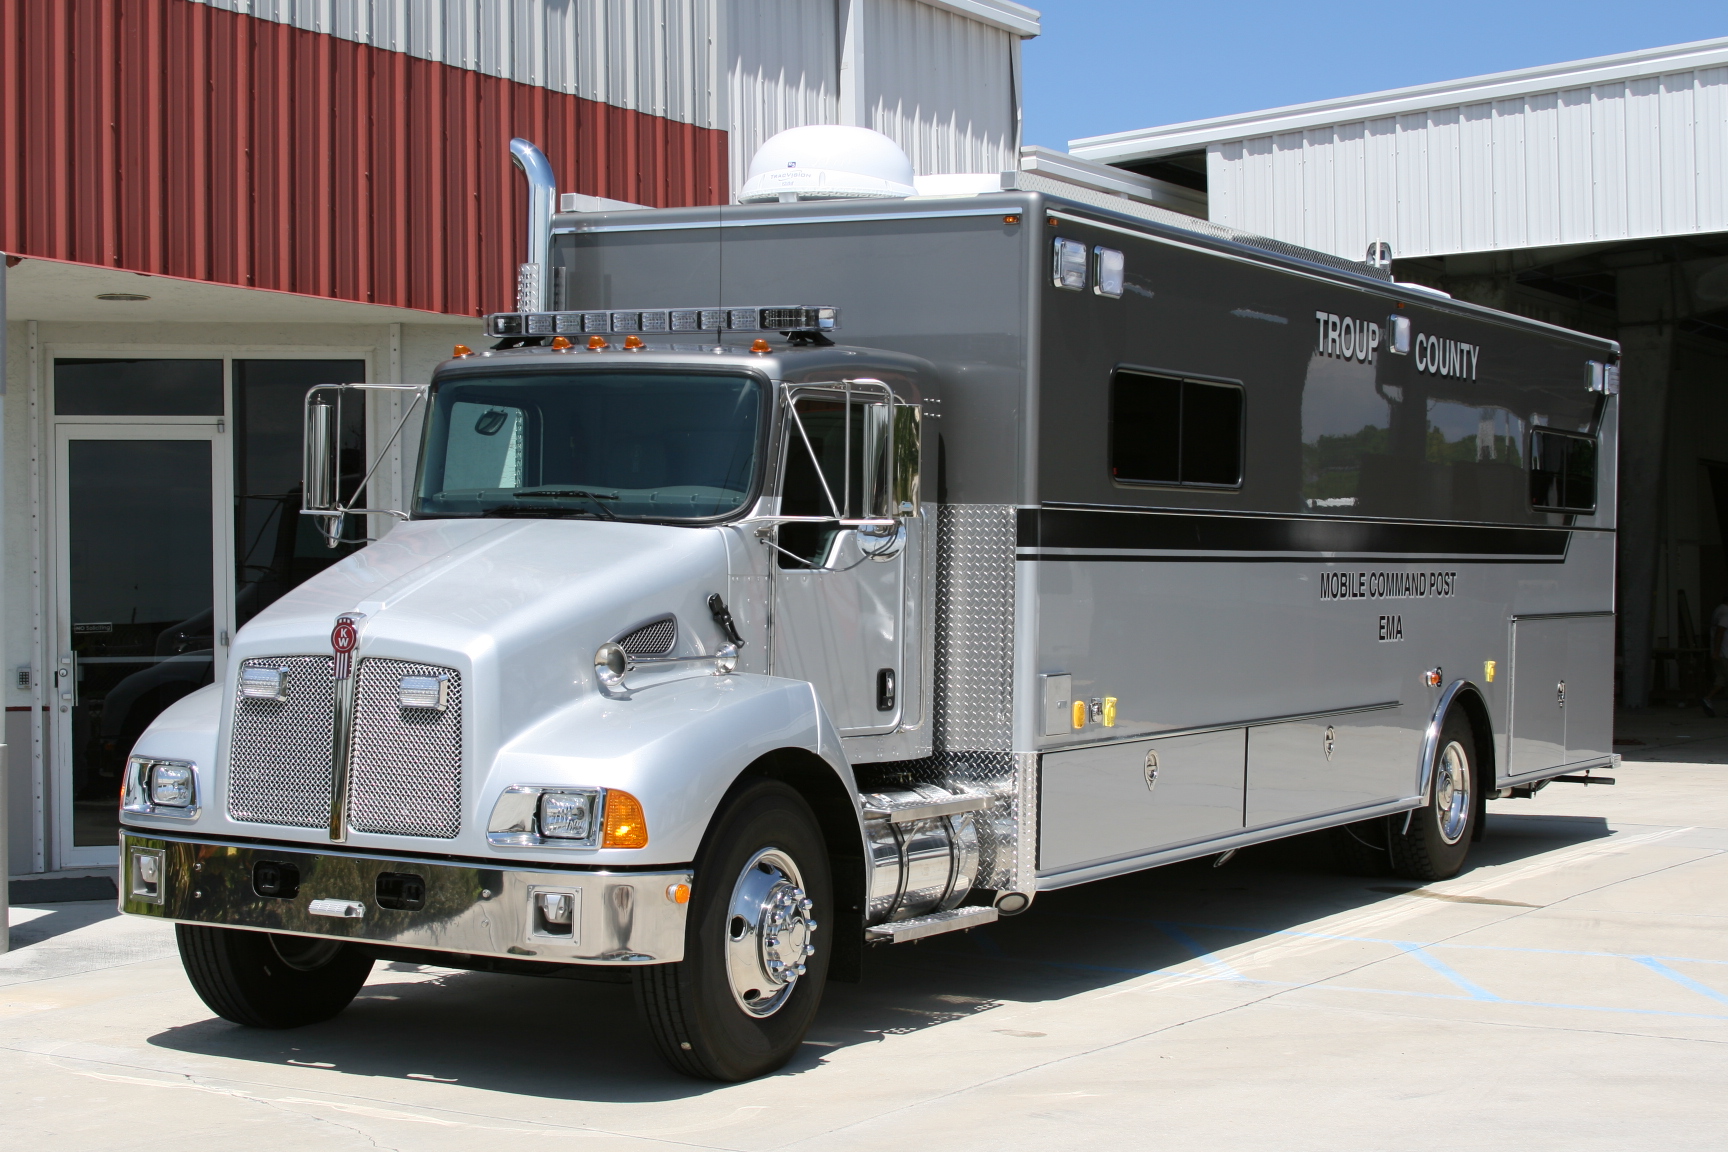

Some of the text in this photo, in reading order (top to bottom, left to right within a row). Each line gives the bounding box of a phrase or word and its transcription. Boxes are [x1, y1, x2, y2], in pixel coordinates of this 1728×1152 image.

[1315, 311, 1479, 381] TROUP COUNTY
[1320, 571, 1457, 599] MOBILE COMMAND POST
[1378, 614, 1404, 642] EMA
